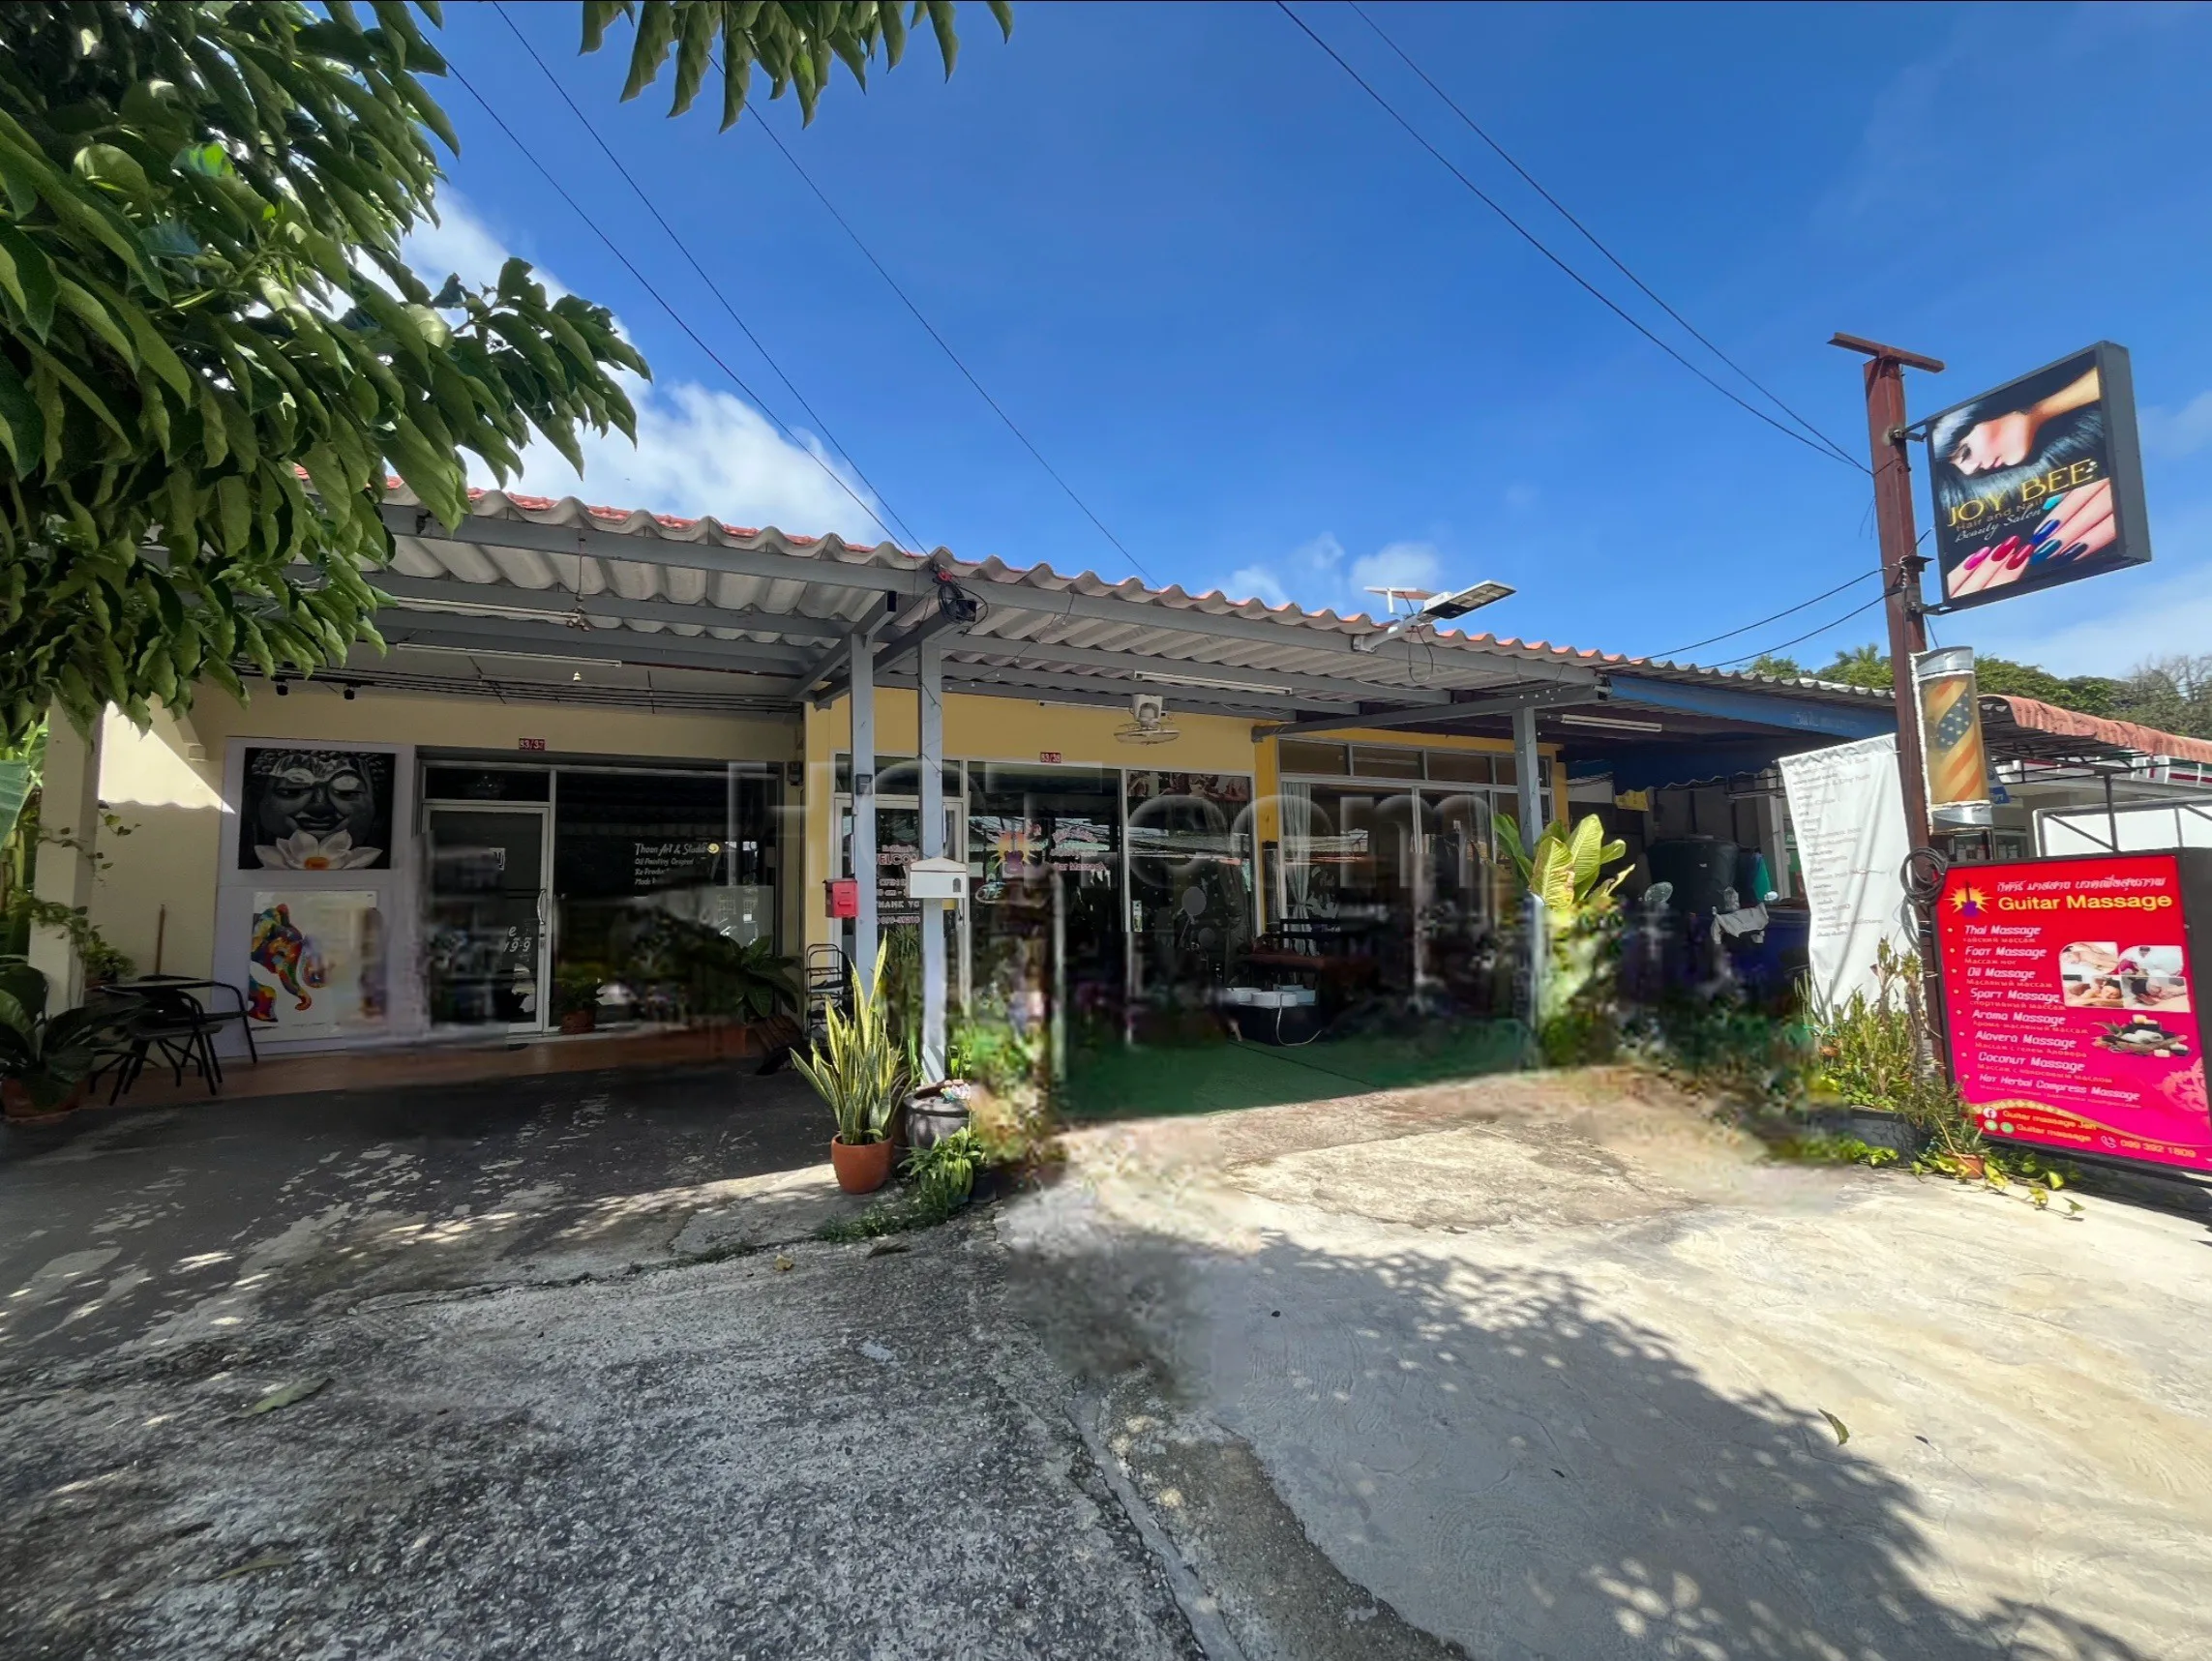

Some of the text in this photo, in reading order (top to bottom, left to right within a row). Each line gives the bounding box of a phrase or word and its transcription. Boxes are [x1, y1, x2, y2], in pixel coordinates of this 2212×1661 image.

[1947, 459, 2094, 527] JOY BEE
[1957, 497, 2045, 532] Hair and Nail
[1955, 507, 2043, 543] Beauty Salon
[673, 844, 681, 855] &
[1998, 895, 2173, 911] Guitar Massage
[1964, 925, 2042, 937] Thai Massage
[1965, 946, 2048, 960] Foot Massage
[1967, 966, 2036, 982] Oil Massage
[1970, 988, 2060, 1004] Sport Massage
[1972, 1009, 2066, 1027] Aroma Massage
[1975, 1030, 2077, 1050] Alovera Massage
[1978, 1052, 2085, 1074] Coconut Massage
[1979, 1073, 1997, 1083] Hot
[2000, 1076, 2033, 1087] Herbal
[2036, 1081, 2087, 1093] Compress
[2091, 1086, 2141, 1102] Massage
[2002, 1111, 2030, 1121] Guitar
[2032, 1114, 2076, 1129] massage
[2016, 1123, 2092, 1142] Guitar massage
